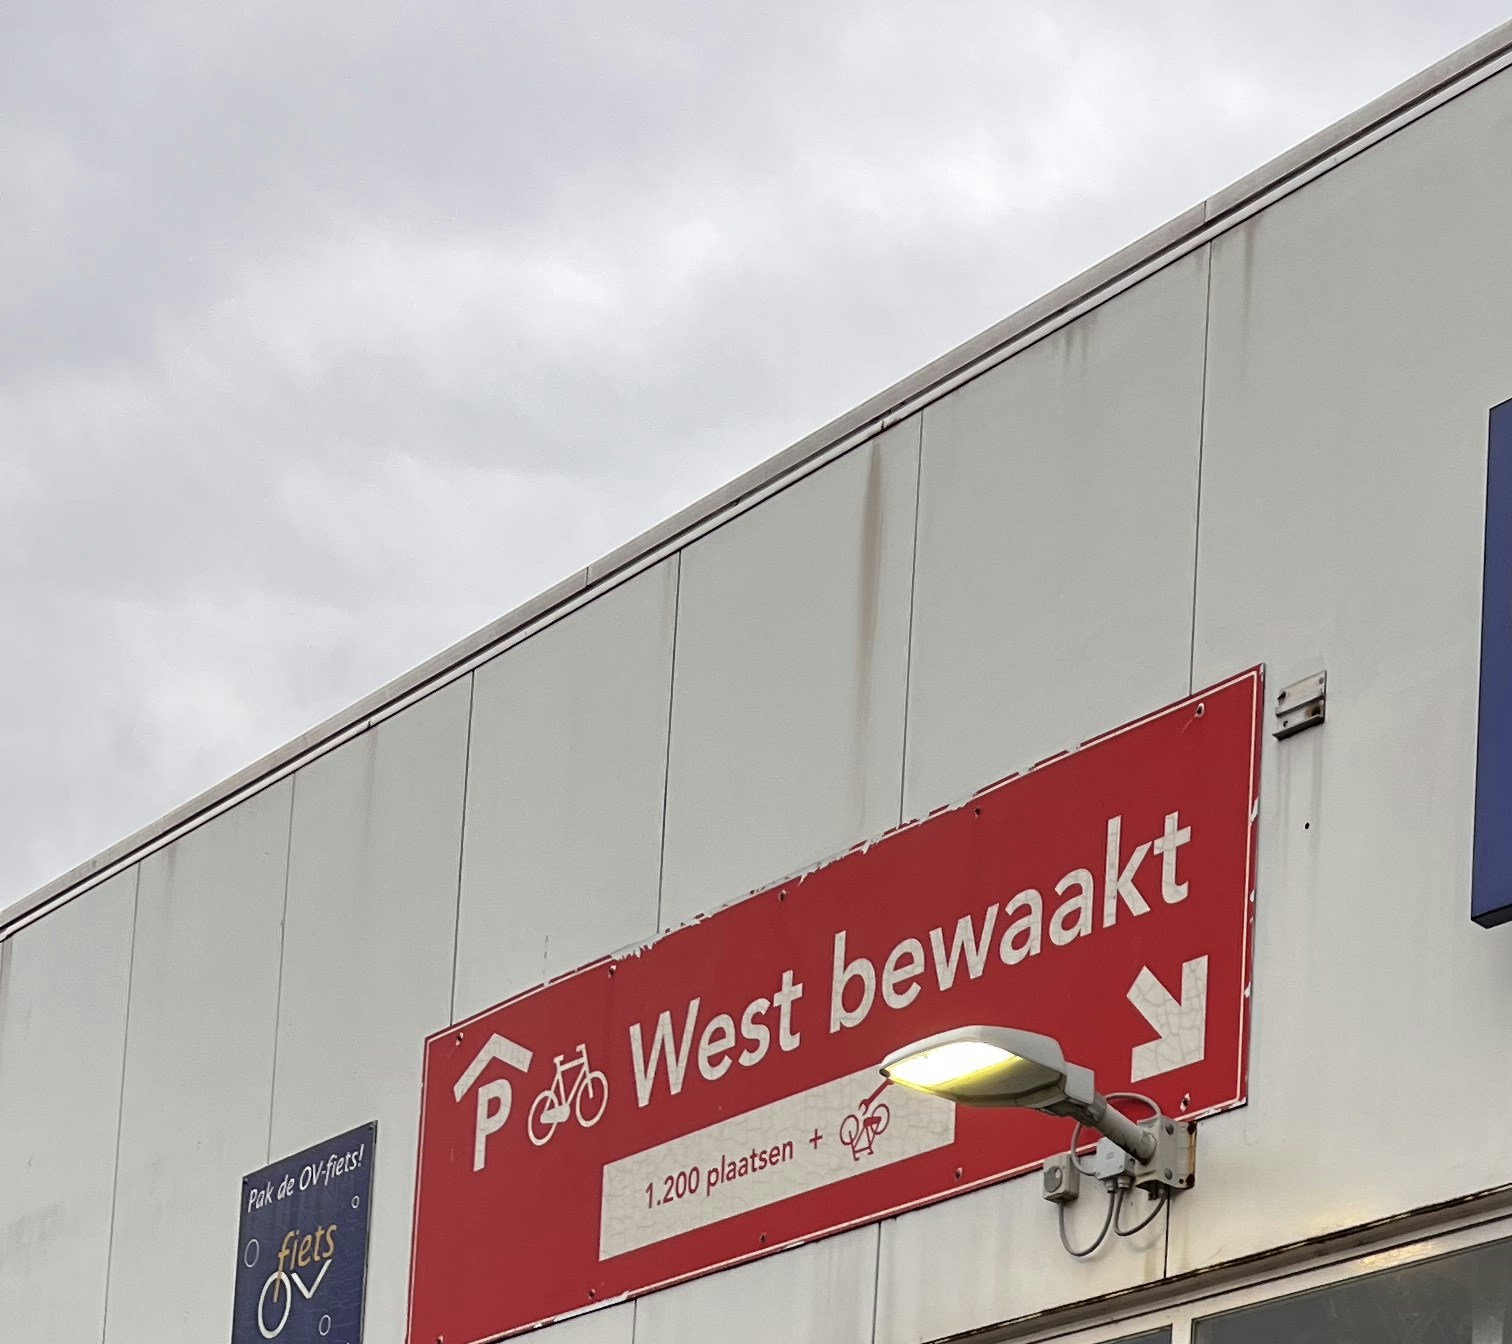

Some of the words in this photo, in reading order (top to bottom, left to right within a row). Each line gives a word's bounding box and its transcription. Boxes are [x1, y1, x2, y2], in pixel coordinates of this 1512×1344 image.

[629, 970, 802, 1108] West
[830, 810, 1191, 1033] bewaakt
[472, 1079, 510, 1172] P
[248, 1182, 272, 1213] Pak
[277, 1176, 294, 1198] de
[300, 1144, 364, 1190] OV-fiets!
[645, 1167, 700, 1210] 1.200
[706, 1138, 794, 1196] plaatsen
[273, 1224, 337, 1302] fiets
